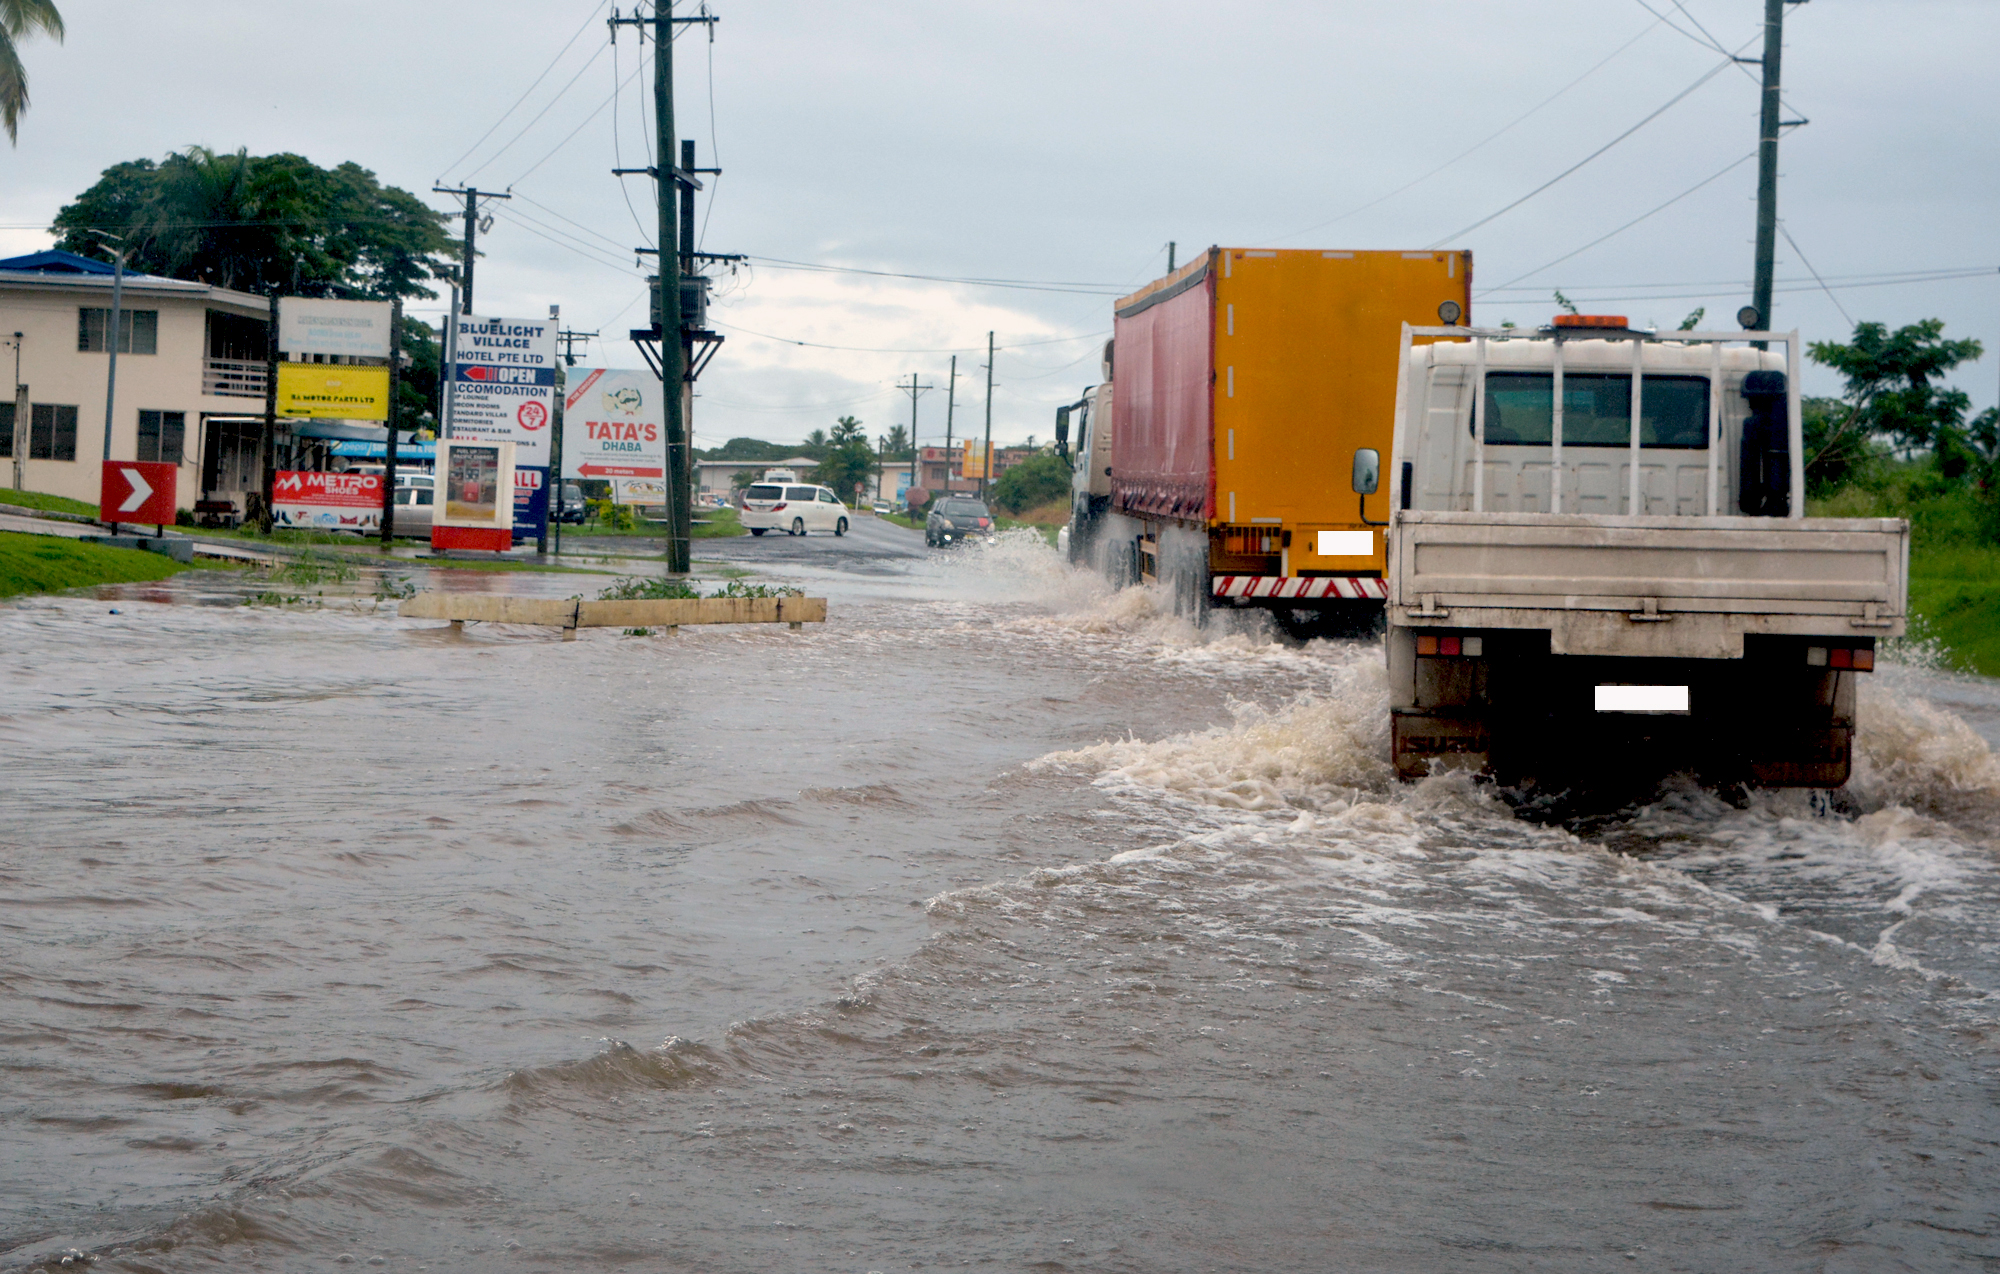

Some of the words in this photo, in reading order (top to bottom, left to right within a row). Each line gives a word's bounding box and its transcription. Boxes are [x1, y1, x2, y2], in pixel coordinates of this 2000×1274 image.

[459, 323, 545, 338] BLUELIGHT
[473, 336, 531, 349] VILLAGE
[457, 350, 494, 362] HOTEL
[498, 352, 520, 362] PTE
[523, 354, 544, 364] LTD
[499, 366, 536, 384] OPEN
[525, 407, 539, 416] 24
[529, 417, 536, 426] 7
[585, 421, 657, 442] TATA'S
[343, 442, 368, 451] pepsi
[602, 441, 642, 452] DHABA
[306, 474, 378, 489] METRO
[324, 486, 359, 495] SHOES
[1399, 735, 1488, 754] ISUZU
